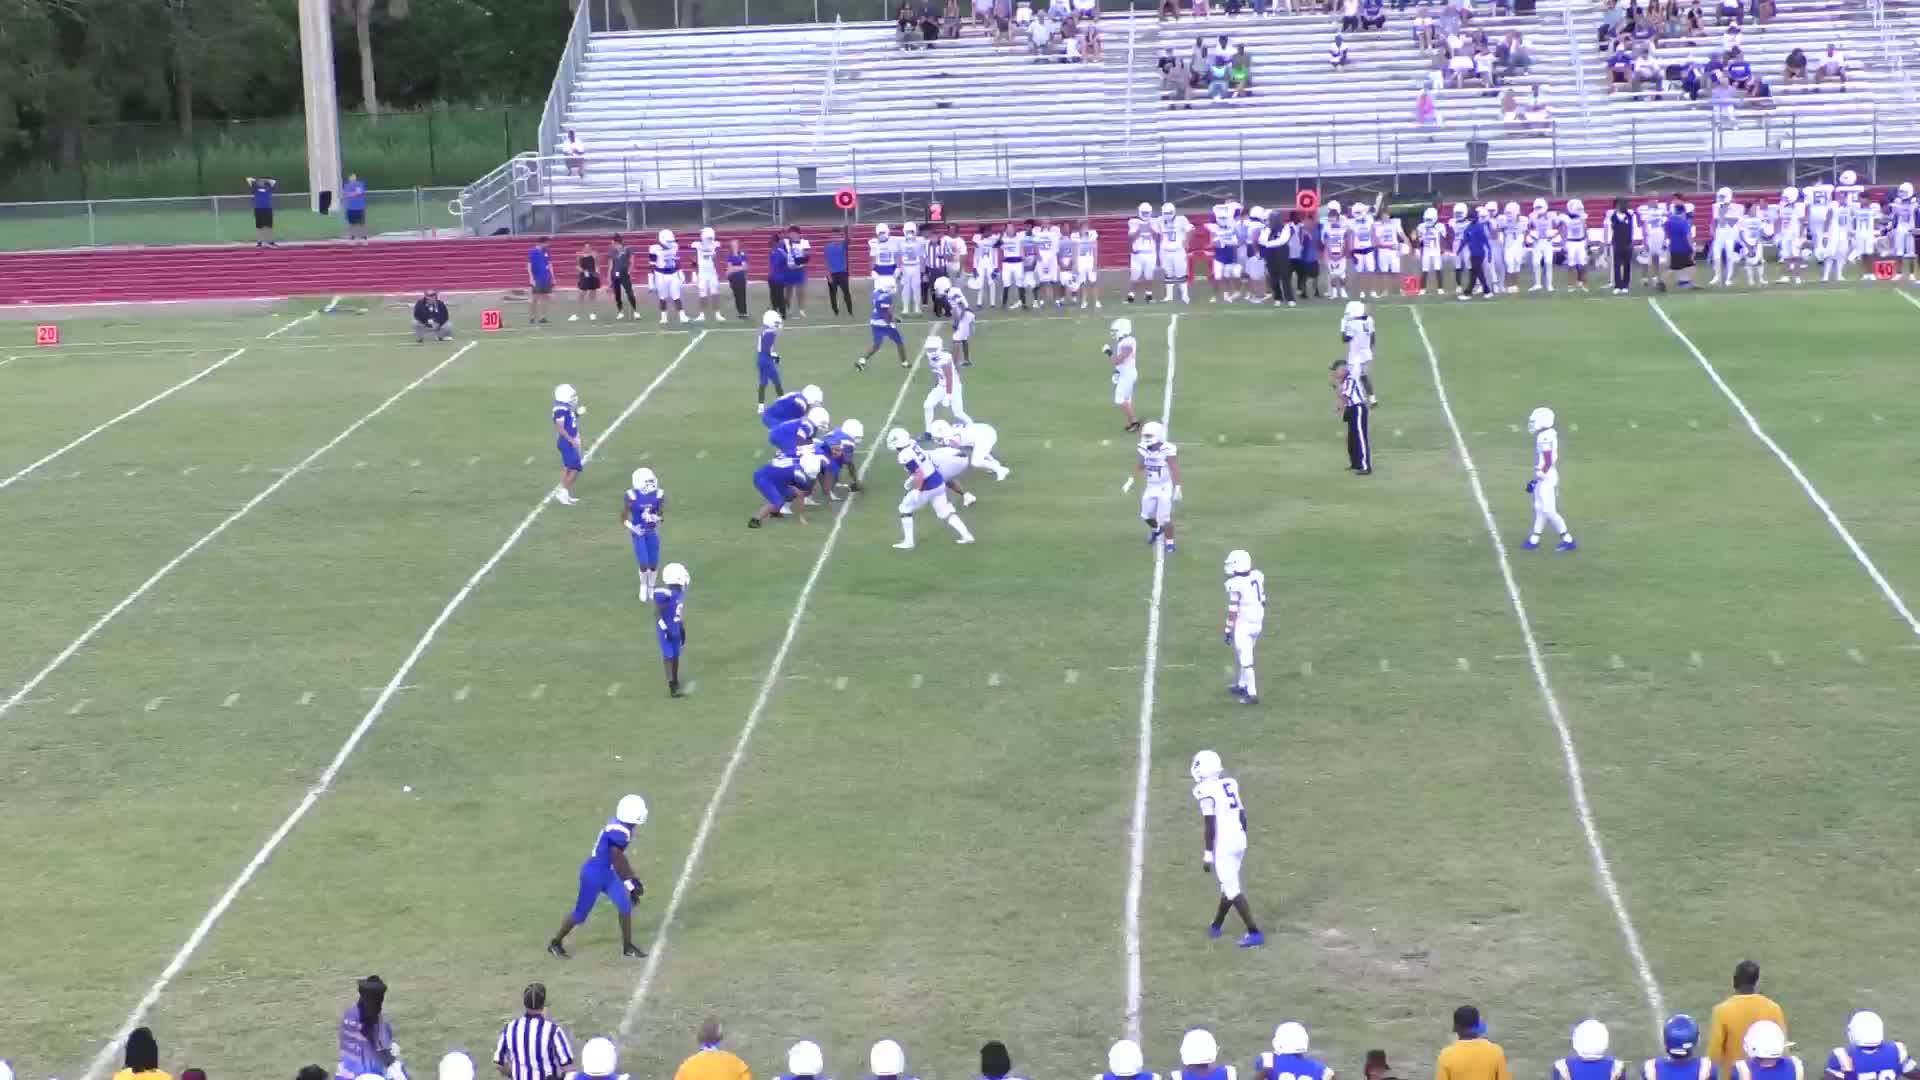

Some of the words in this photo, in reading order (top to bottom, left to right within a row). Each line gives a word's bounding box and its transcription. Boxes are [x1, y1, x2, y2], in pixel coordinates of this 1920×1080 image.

[929, 203, 942, 221] 2
[1878, 262, 1893, 276] 40
[483, 311, 498, 326] 30
[39, 327, 55, 341] 20
[1250, 579, 1261, 602] 7
[1222, 782, 1239, 809] 5
